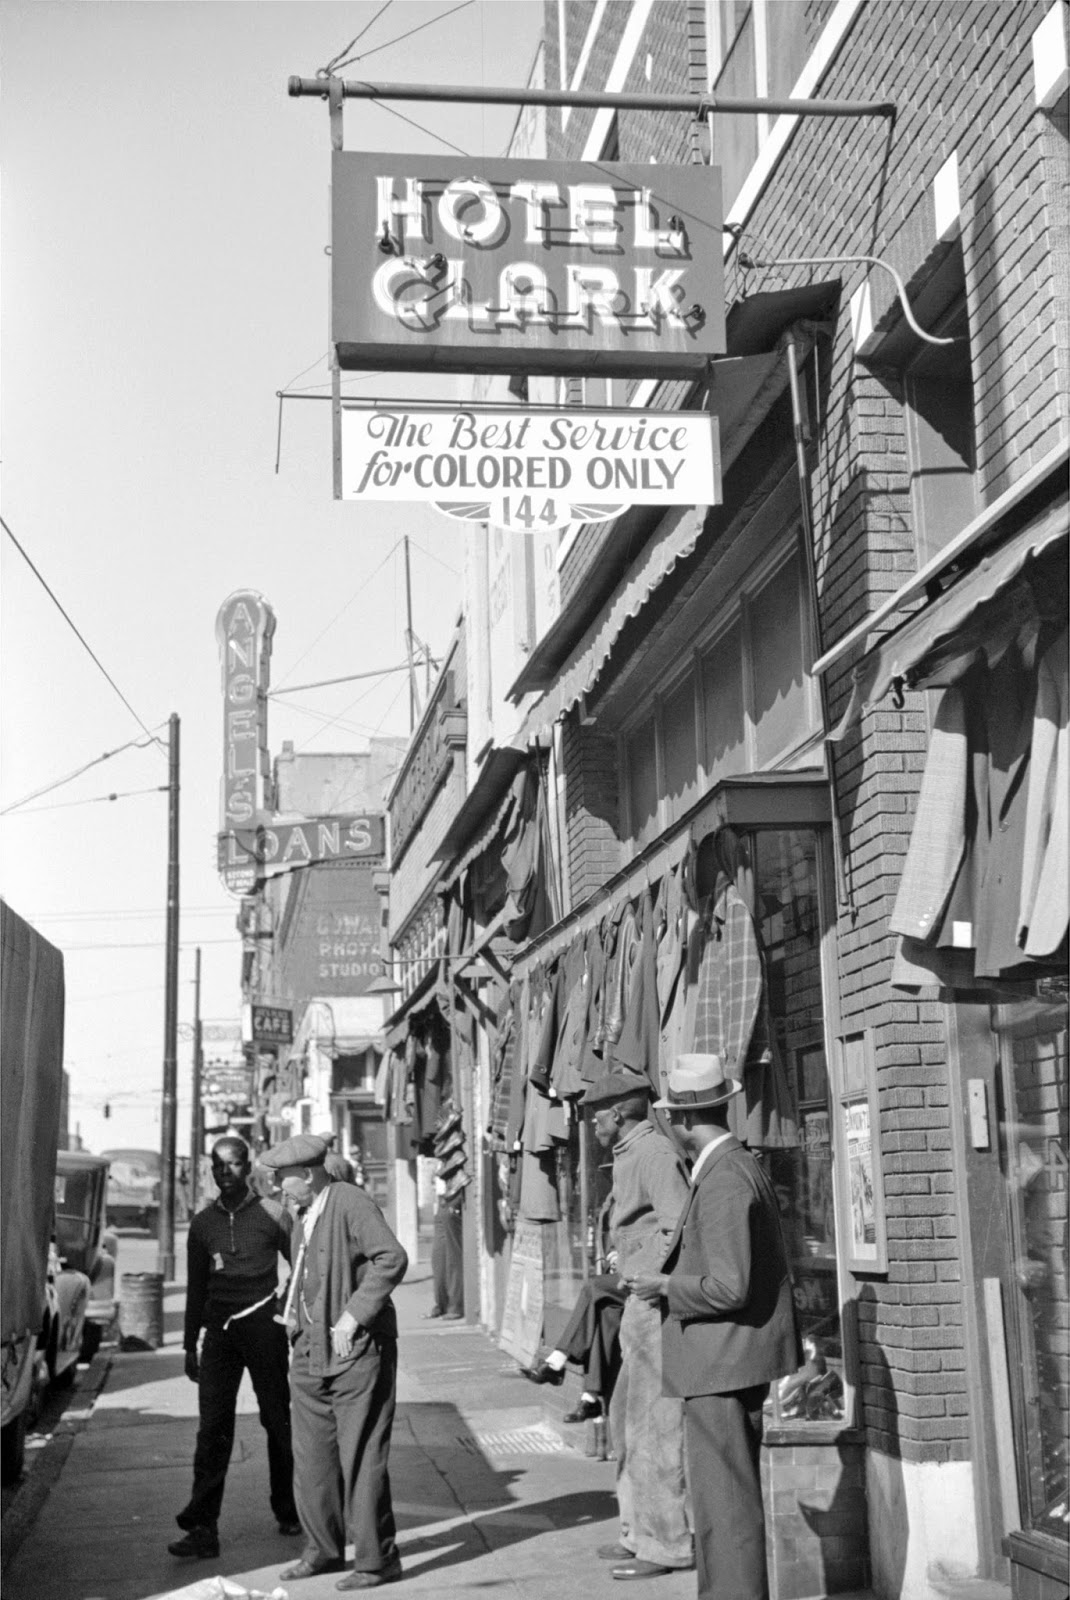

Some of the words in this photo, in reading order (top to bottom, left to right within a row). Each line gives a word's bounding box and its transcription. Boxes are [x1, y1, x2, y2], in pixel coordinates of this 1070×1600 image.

[375, 175, 686, 249] HOTEL
[371, 256, 690, 328] CLARK
[367, 414, 432, 448] The
[449, 413, 531, 450] Best
[542, 417, 689, 452] Service
[353, 450, 412, 493] for
[413, 452, 571, 489] COLORED
[586, 456, 686, 490] ONLY
[502, 494, 558, 526] 144
[228, 818, 372, 865] LOANS
[319, 941, 380, 956] PHOTO
[319, 962, 380, 977] STUDIO
[253, 1015, 290, 1033] CAFE
